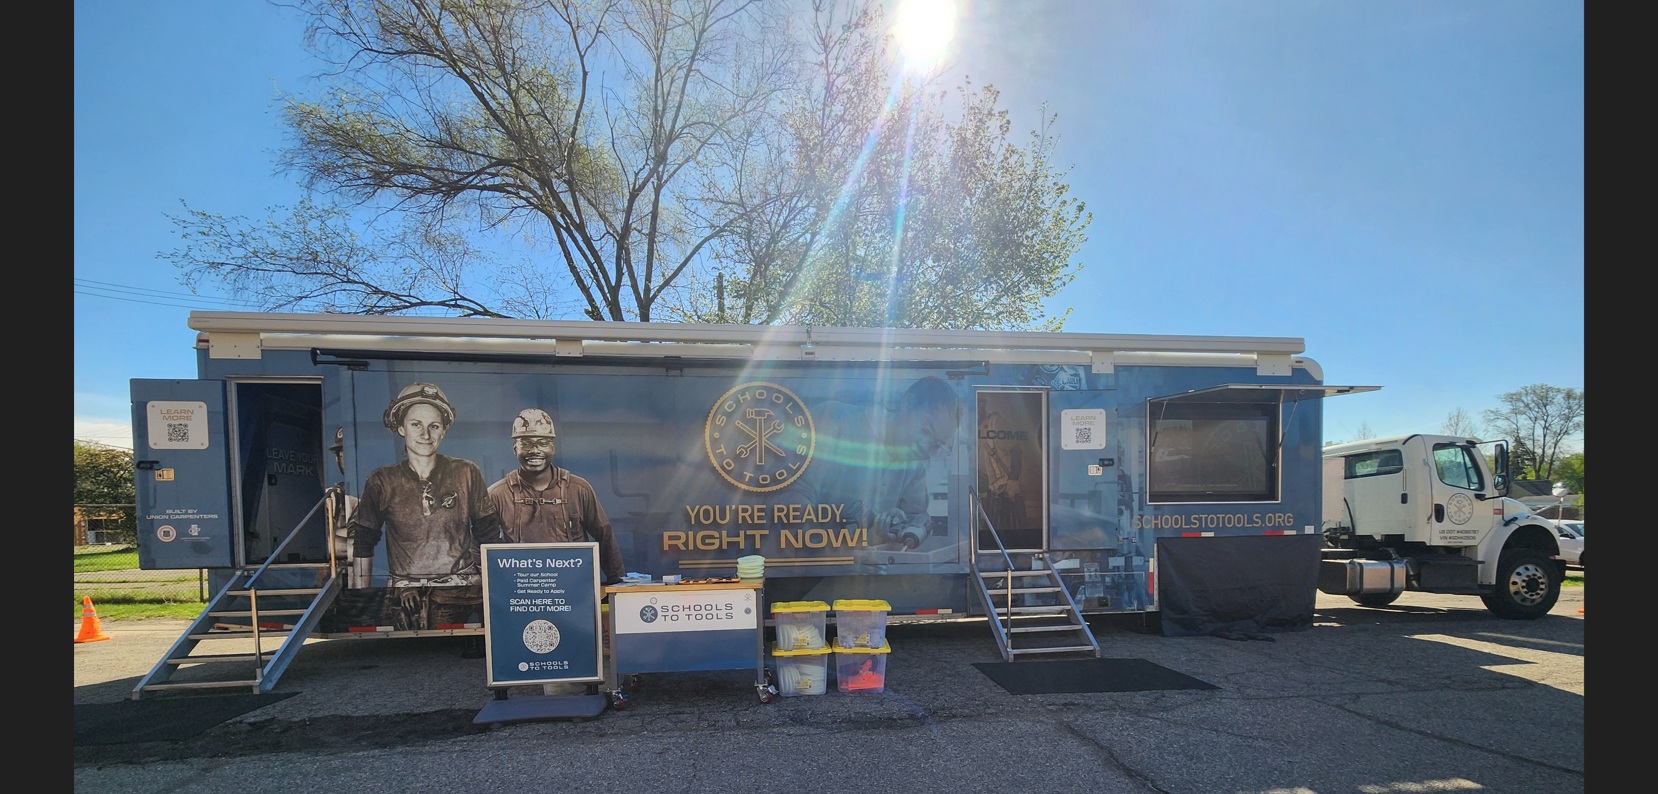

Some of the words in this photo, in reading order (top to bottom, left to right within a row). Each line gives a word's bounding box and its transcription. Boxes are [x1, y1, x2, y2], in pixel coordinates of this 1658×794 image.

[715, 389, 805, 427] SCHOOLS
[266, 447, 296, 461] LEAVE
[297, 452, 319, 464] YOUR
[273, 461, 314, 477] MARK
[716, 444, 735, 471] TO
[743, 445, 807, 484] TOOLS
[686, 504, 767, 525] YOU'RE
[773, 503, 847, 524] READY.
[1132, 513, 1294, 529] SCHOOLSTOTOOLS.ORG
[663, 529, 769, 551] RIGHT
[780, 528, 868, 549] NOW!
[497, 558, 543, 568] What's
[546, 558, 583, 568] Next?
[660, 603, 734, 613] SCHOOLS
[661, 614, 679, 622] TO
[685, 612, 734, 621] TOOLS
